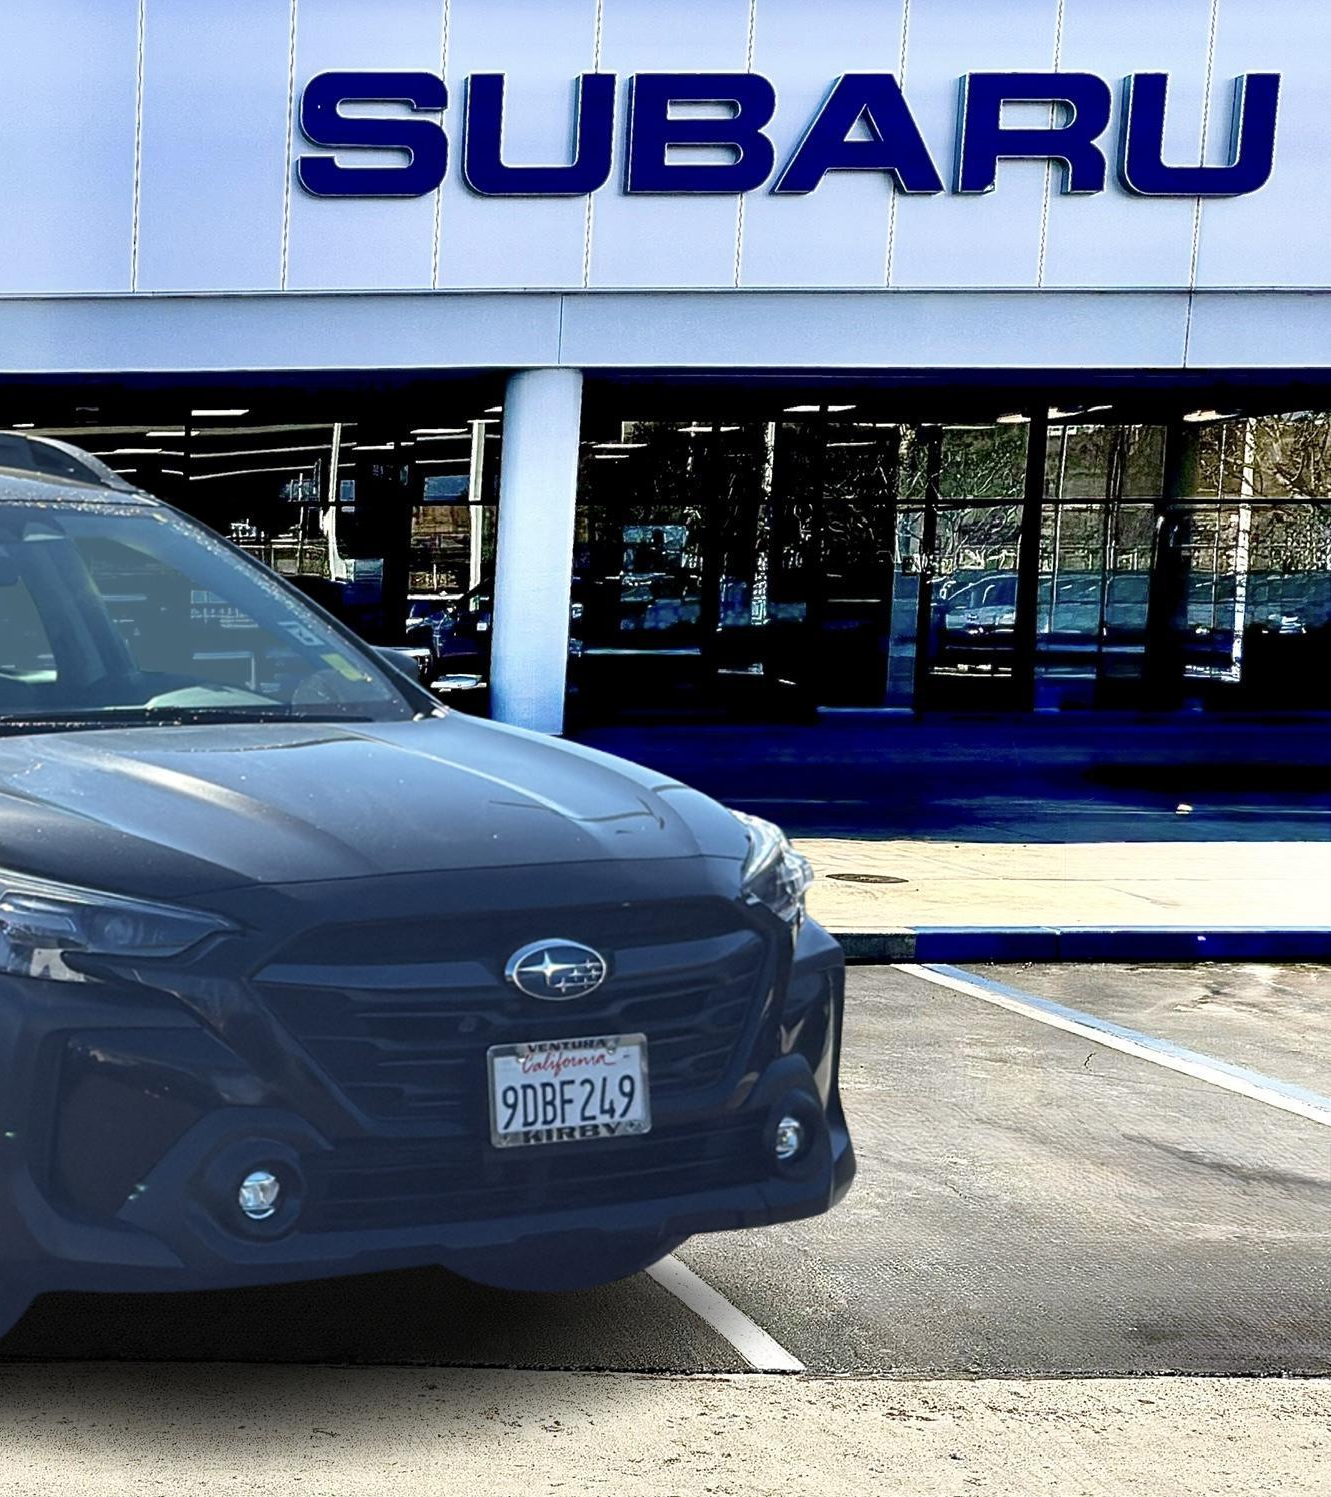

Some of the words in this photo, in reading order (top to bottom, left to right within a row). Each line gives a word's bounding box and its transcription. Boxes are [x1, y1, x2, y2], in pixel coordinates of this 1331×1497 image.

[296, 70, 1281, 198] SUBARU
[527, 1038, 607, 1053] VENTURA
[522, 1051, 616, 1077] California
[502, 1074, 635, 1130] 9DBF249
[522, 1122, 621, 1144] KIRBY
